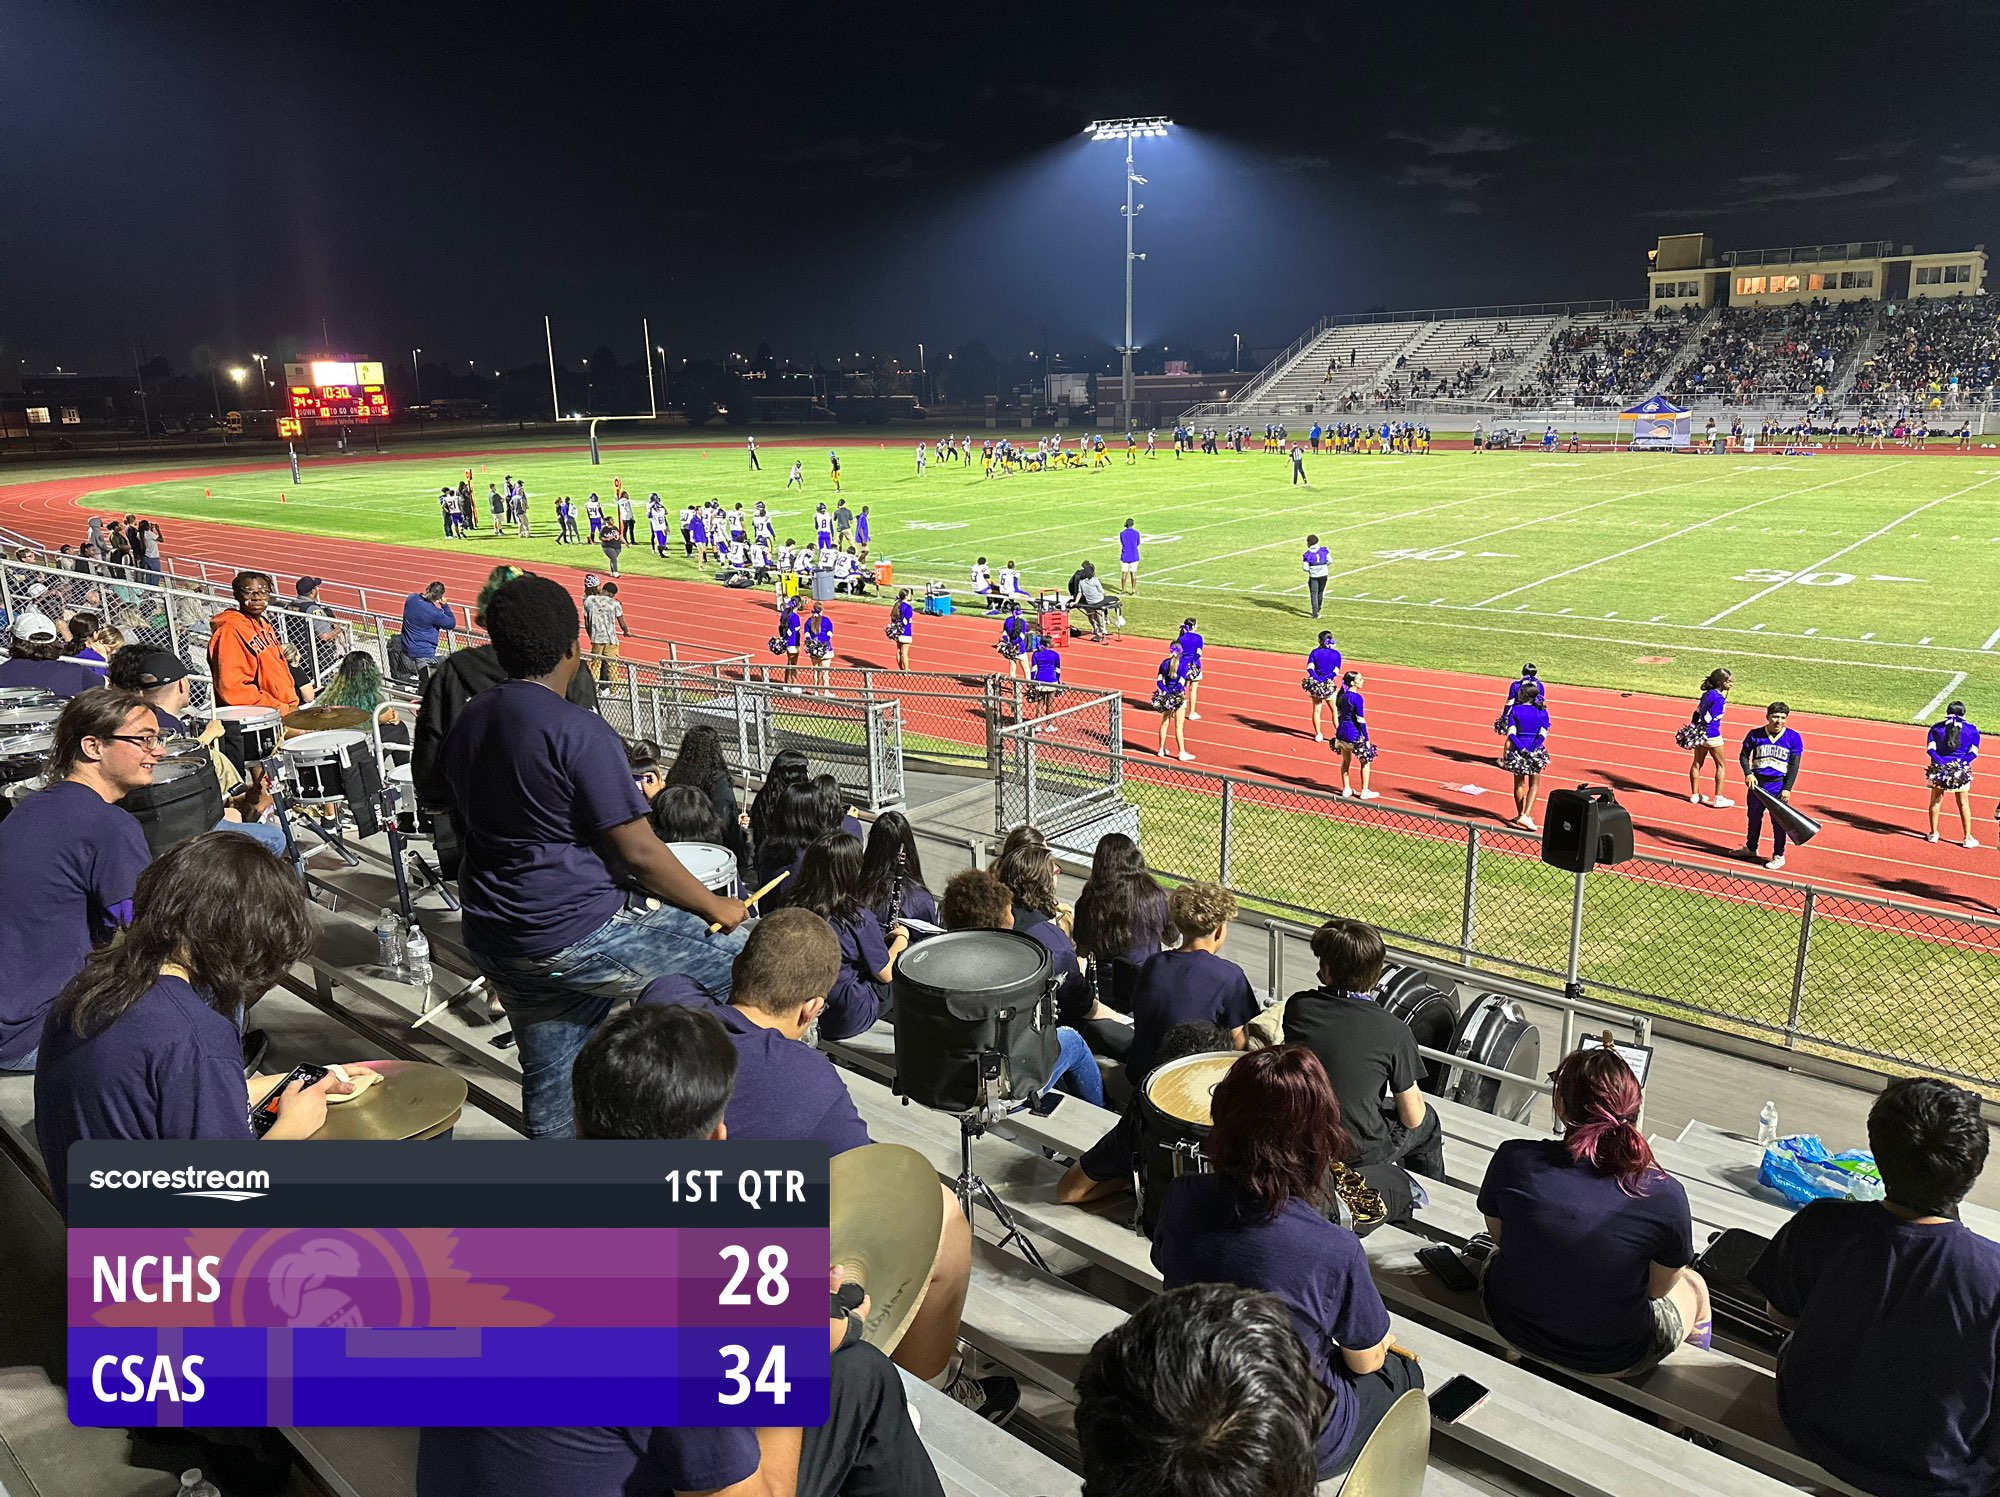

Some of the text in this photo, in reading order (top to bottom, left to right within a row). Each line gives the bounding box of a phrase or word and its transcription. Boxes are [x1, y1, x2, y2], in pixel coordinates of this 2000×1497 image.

[371, 395, 384, 404] 28
[279, 419, 302, 436] 24
[822, 519, 827, 528] 8
[1315, 553, 1321, 563] 1
[1001, 573, 1007, 585] 6
[1731, 568, 1856, 586] 30
[1756, 744, 1790, 760] KNIGHTS
